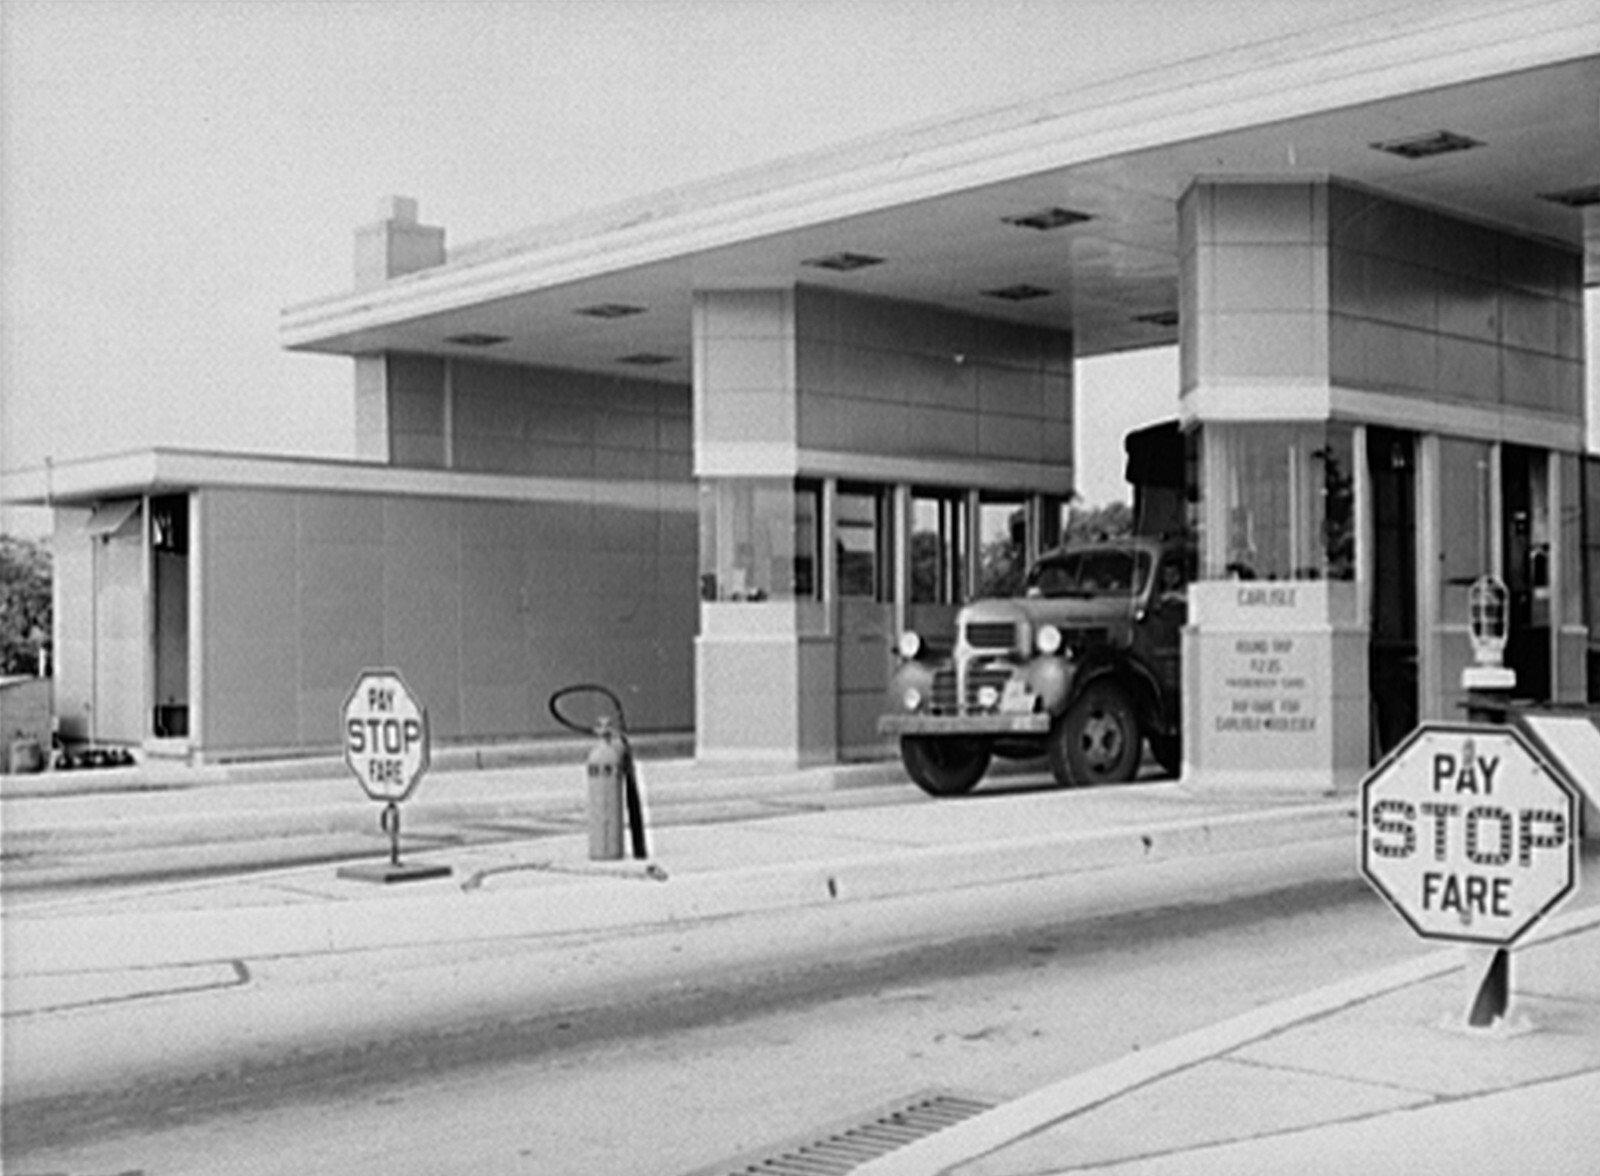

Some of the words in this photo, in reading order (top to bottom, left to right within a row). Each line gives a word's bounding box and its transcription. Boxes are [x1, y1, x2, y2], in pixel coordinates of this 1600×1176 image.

[1237, 588, 1296, 607] CARLISLE
[369, 687, 396, 712] PAY
[348, 718, 420, 754] STOP
[369, 759, 403, 786] FARE
[1433, 753, 1500, 794] PAY
[1371, 799, 1567, 868] STOP
[1422, 872, 1513, 918] FARE
